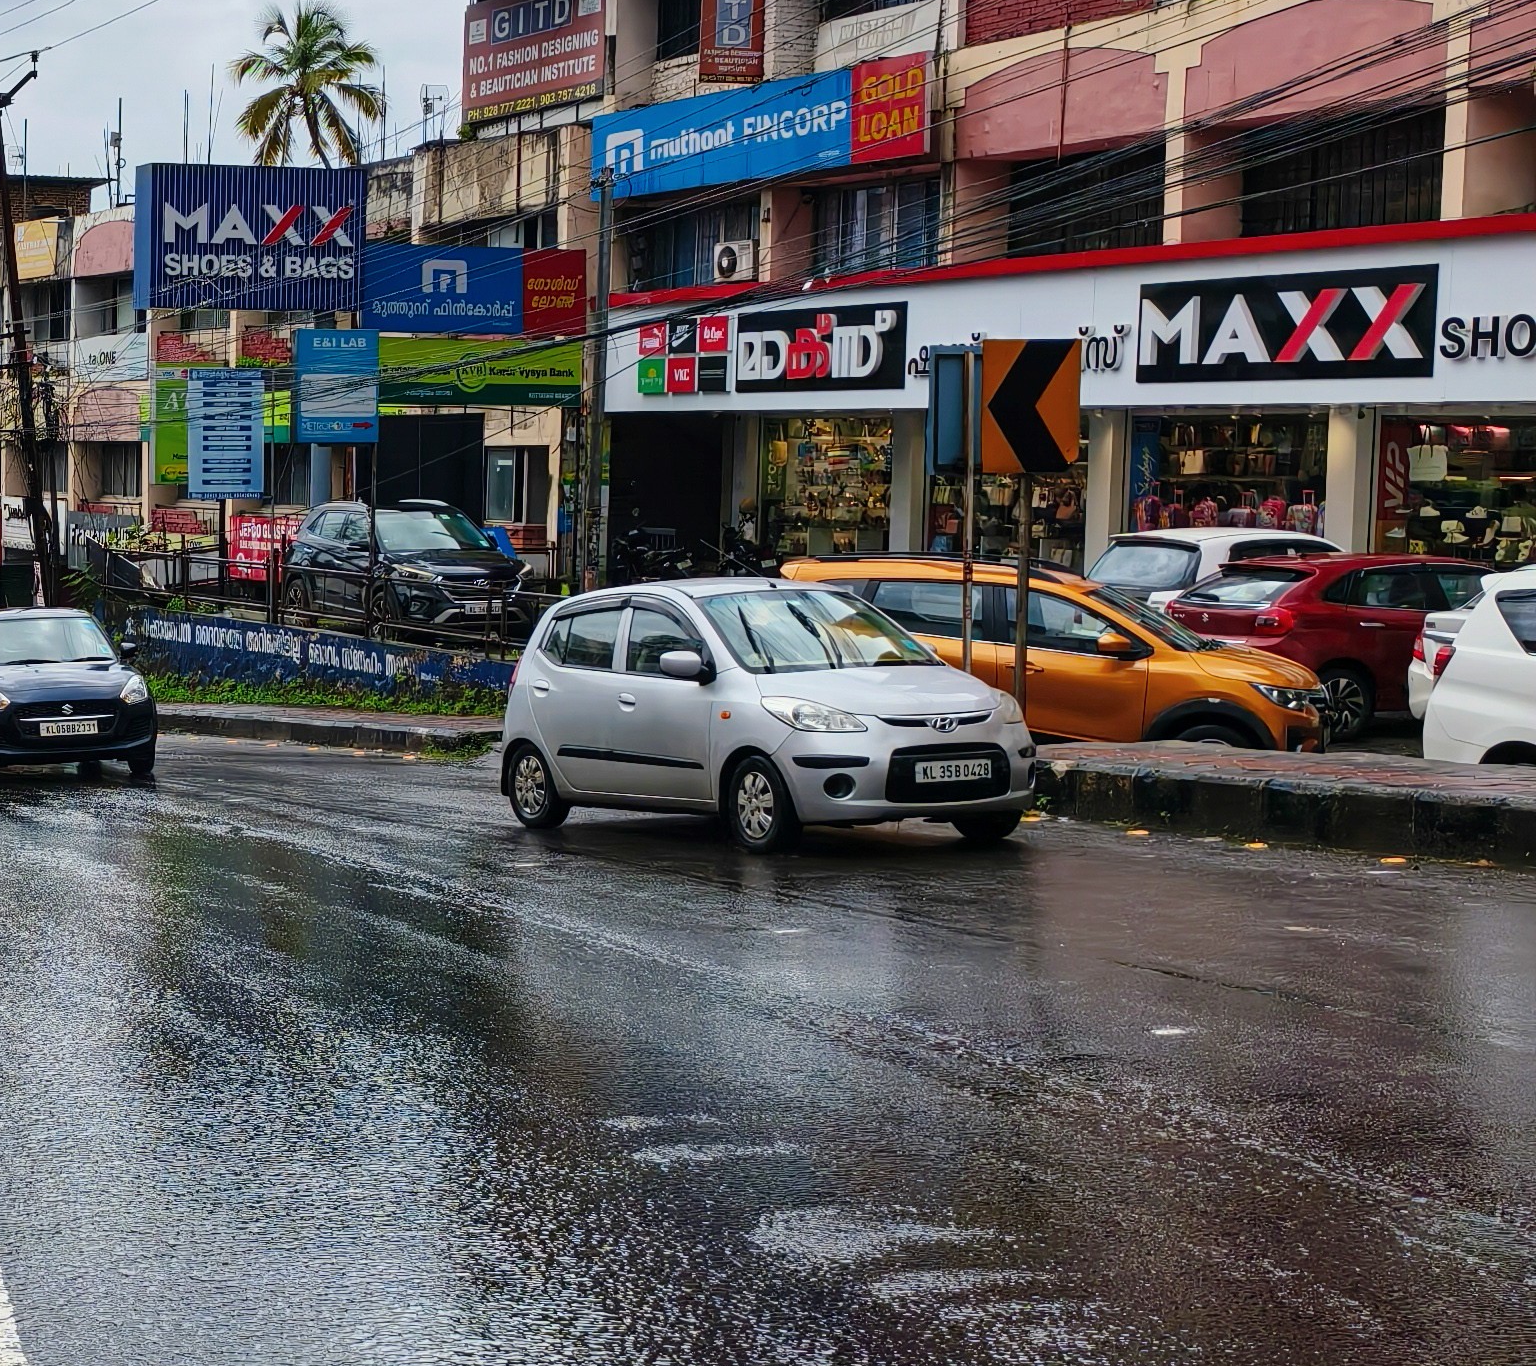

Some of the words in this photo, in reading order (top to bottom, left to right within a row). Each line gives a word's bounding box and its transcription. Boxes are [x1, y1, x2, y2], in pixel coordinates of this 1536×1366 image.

[469, 53, 493, 75] NO.1
[496, 44, 539, 69] FASHION
[541, 29, 599, 59] DESIGNING
[470, 82, 477, 98] &
[480, 68, 538, 96] BEAUTICIAN
[541, 55, 596, 83] INSTITUTE
[860, 67, 923, 104] GOLD
[743, 101, 848, 146] FINCORP
[858, 105, 920, 142] LOAN
[164, 202, 354, 247] MAXX
[164, 252, 253, 278] SHOES
[260, 254, 277, 278] &
[284, 256, 355, 280] BAGS
[340, 337, 367, 348] LAB
[1141, 282, 1427, 366] MAXX
[737, 309, 897, 381] മാക്സ്
[519, 367, 548, 379] Vysya
[550, 367, 575, 378] Bank
[674, 368, 690, 382] VKC
[1384, 440, 1407, 509] VIP
[922, 765, 937, 780] KL
[963, 762, 990, 778] 0428
